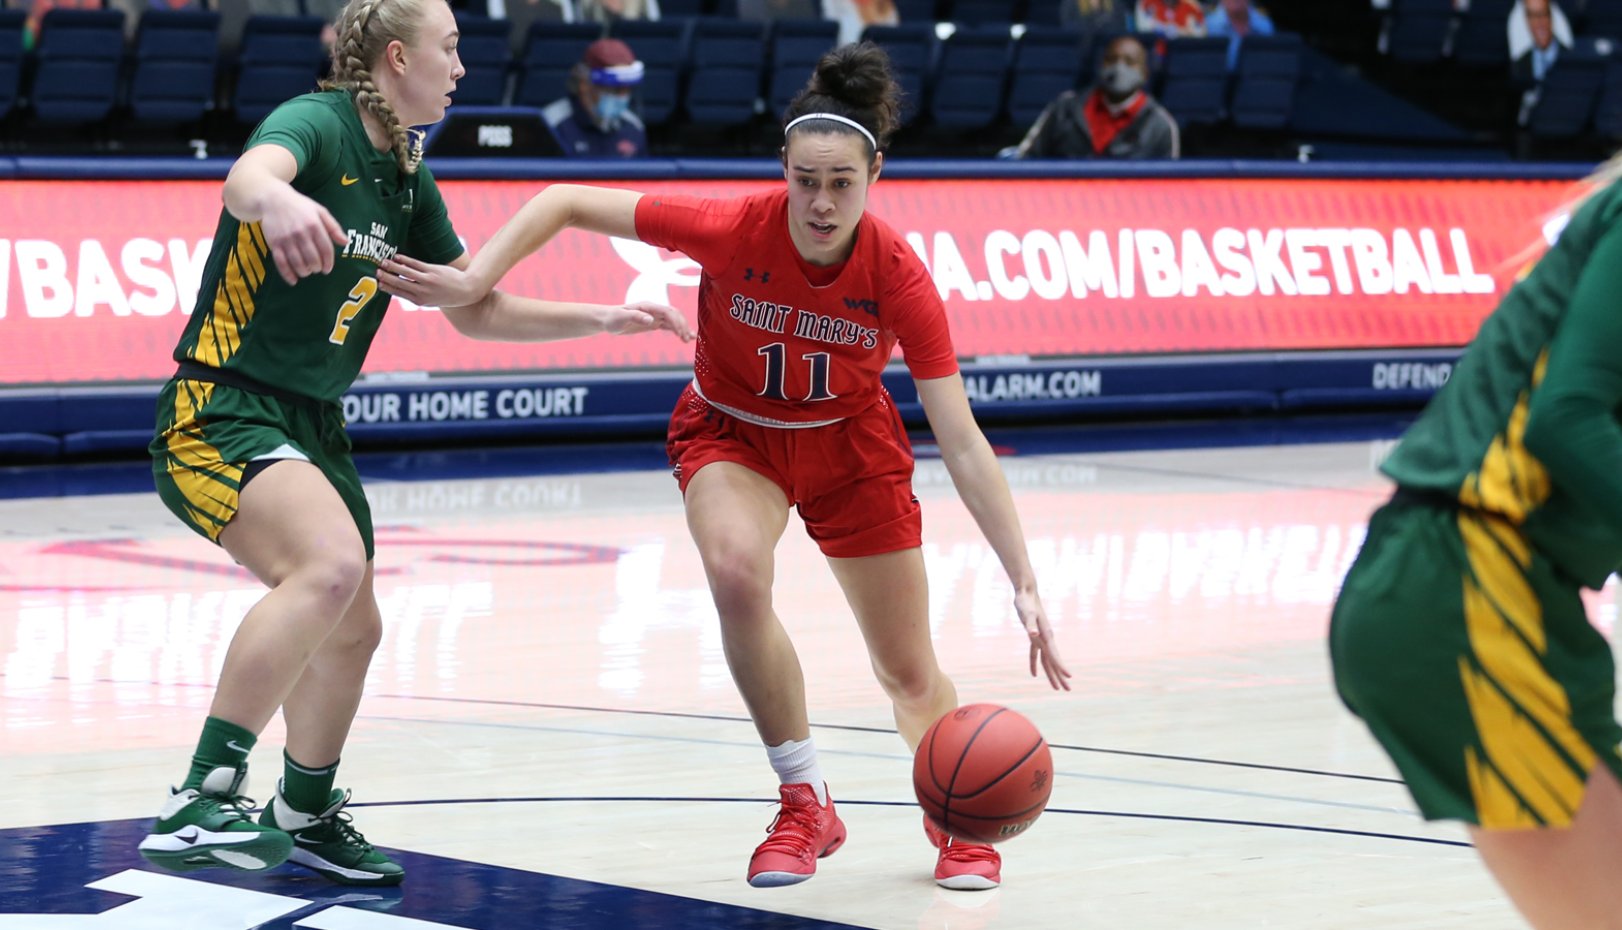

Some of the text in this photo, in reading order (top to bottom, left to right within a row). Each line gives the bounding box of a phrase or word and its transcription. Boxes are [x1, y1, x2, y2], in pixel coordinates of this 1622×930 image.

[342, 228, 398, 262] FRANCISC
[370, 221, 388, 240] SAN
[329, 275, 378, 346] 2
[729, 292, 793, 334] SAINT
[756, 342, 838, 402] 11
[963, 370, 1101, 402] ALARM.COM
[340, 387, 589, 424] OUR HOME COURT
